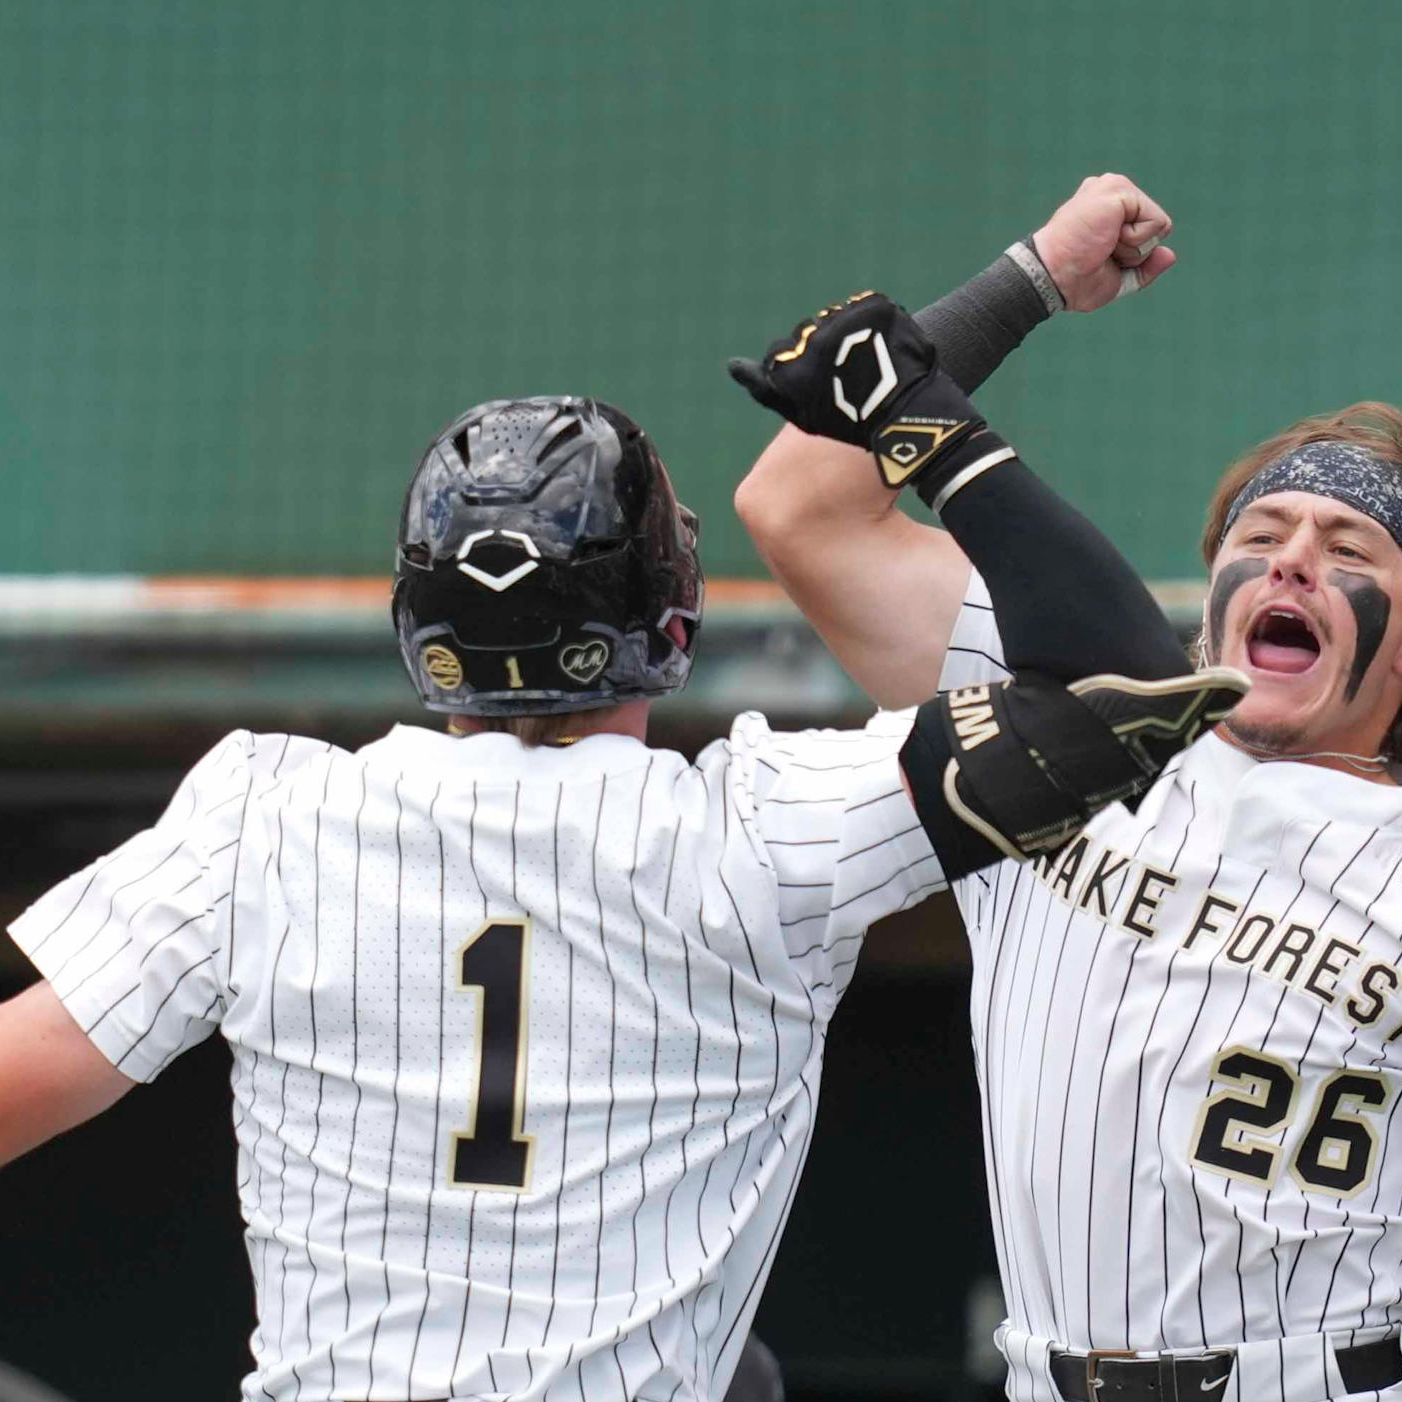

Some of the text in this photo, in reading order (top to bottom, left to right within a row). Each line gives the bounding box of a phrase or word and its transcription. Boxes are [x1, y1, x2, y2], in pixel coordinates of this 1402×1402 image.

[504, 656, 524, 689] 1
[445, 917, 538, 1194] 1
[1189, 1045, 1392, 1200] 26
